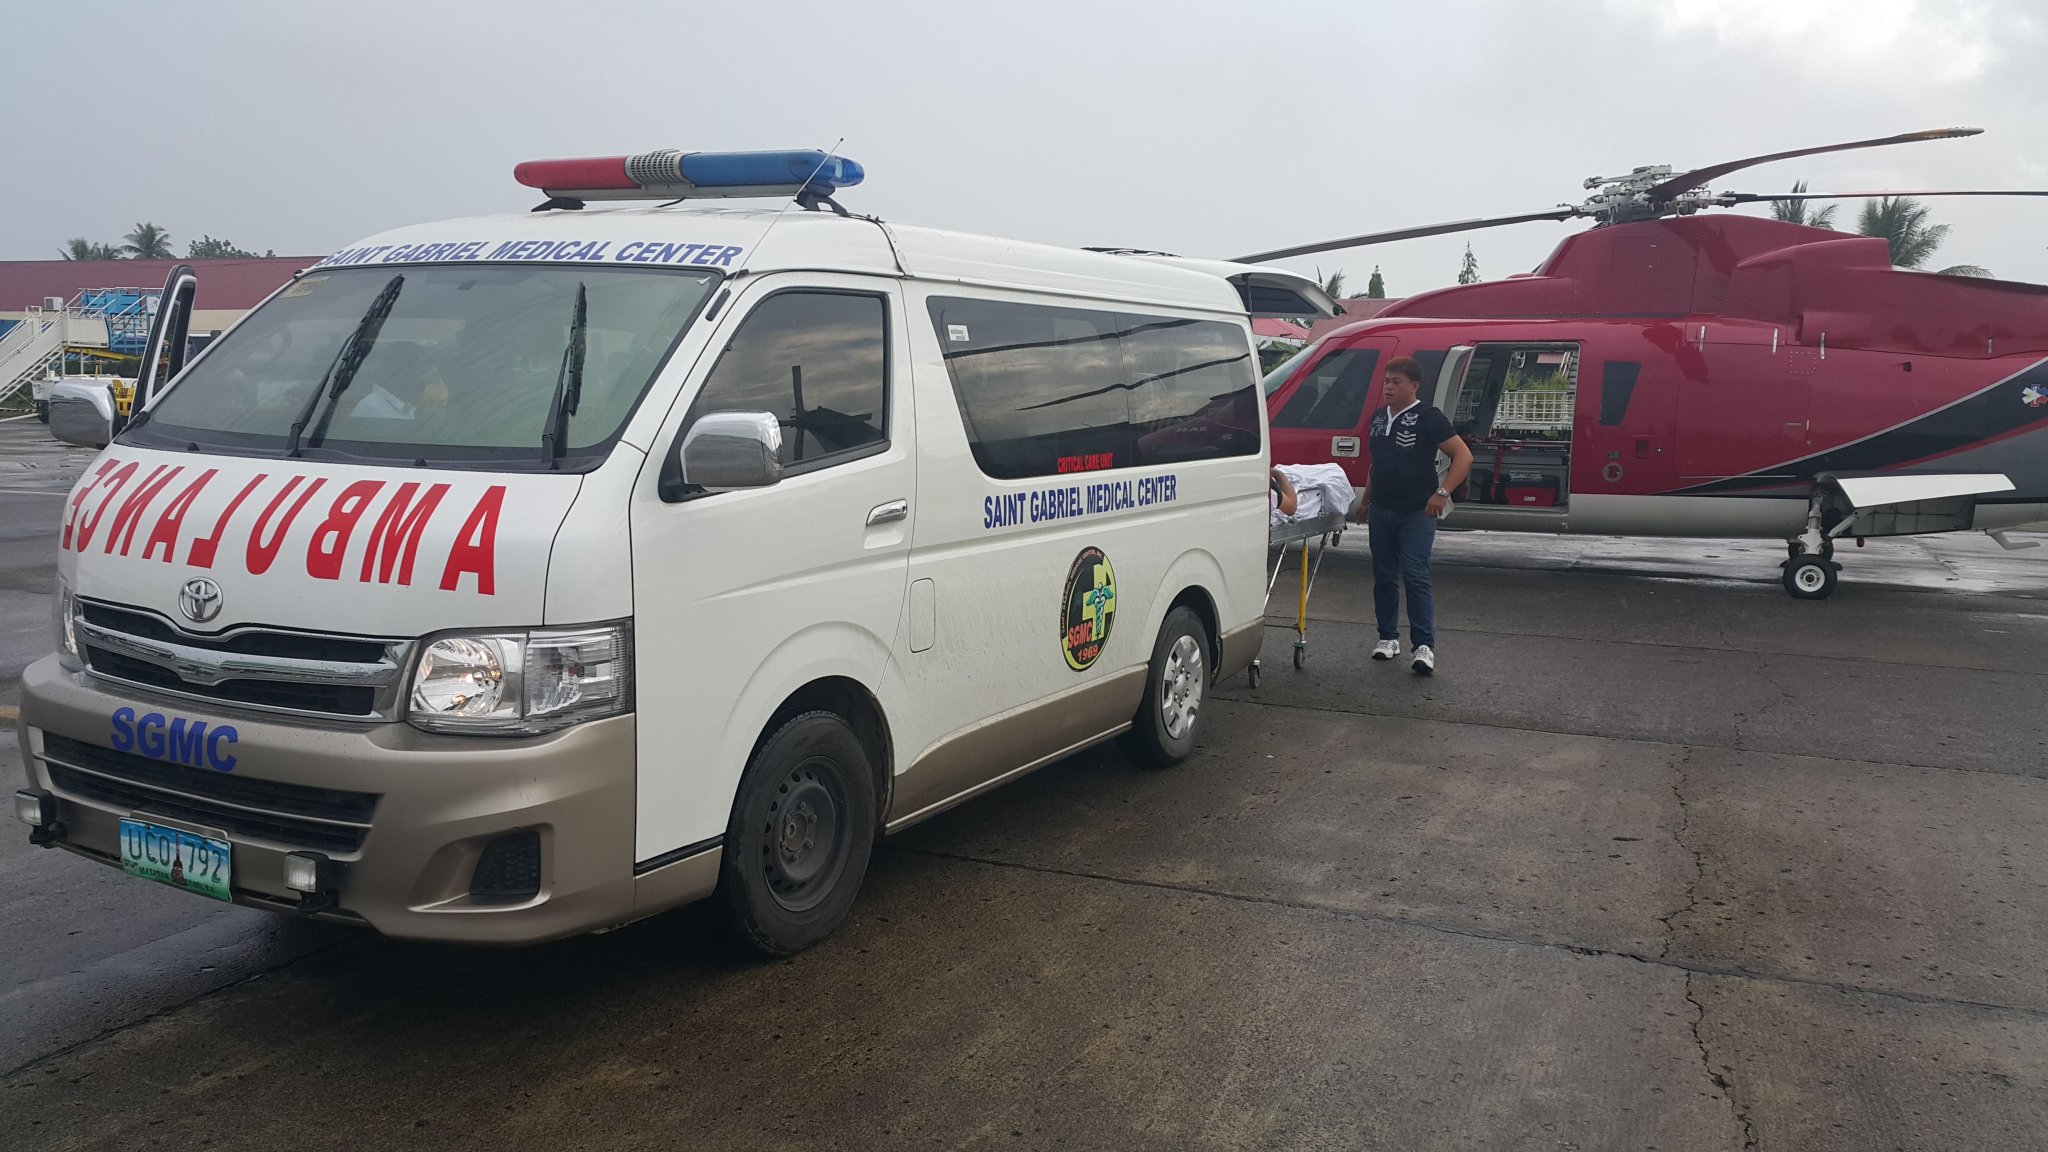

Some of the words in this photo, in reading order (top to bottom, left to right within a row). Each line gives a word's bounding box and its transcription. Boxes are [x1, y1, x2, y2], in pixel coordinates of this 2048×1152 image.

[315, 245, 394, 266] SAINT
[382, 241, 490, 262] GABRIEL
[487, 240, 611, 261] MEDICAL
[614, 241, 744, 267] CENTER
[1057, 456, 1084, 473] CRITICAL
[1085, 454, 1099, 470] CARE
[1100, 452, 1113, 468] UNIT
[984, 493, 1026, 529] SAINT
[1030, 487, 1083, 523] GABRIEL
[1087, 480, 1134, 514] MEDICAL
[1138, 474, 1176, 506] CENTER
[1068, 620, 1093, 648] SGMC
[1077, 643, 1099, 662] 1969
[111, 706, 238, 772] SGMC
[184, 841, 221, 883] 792
